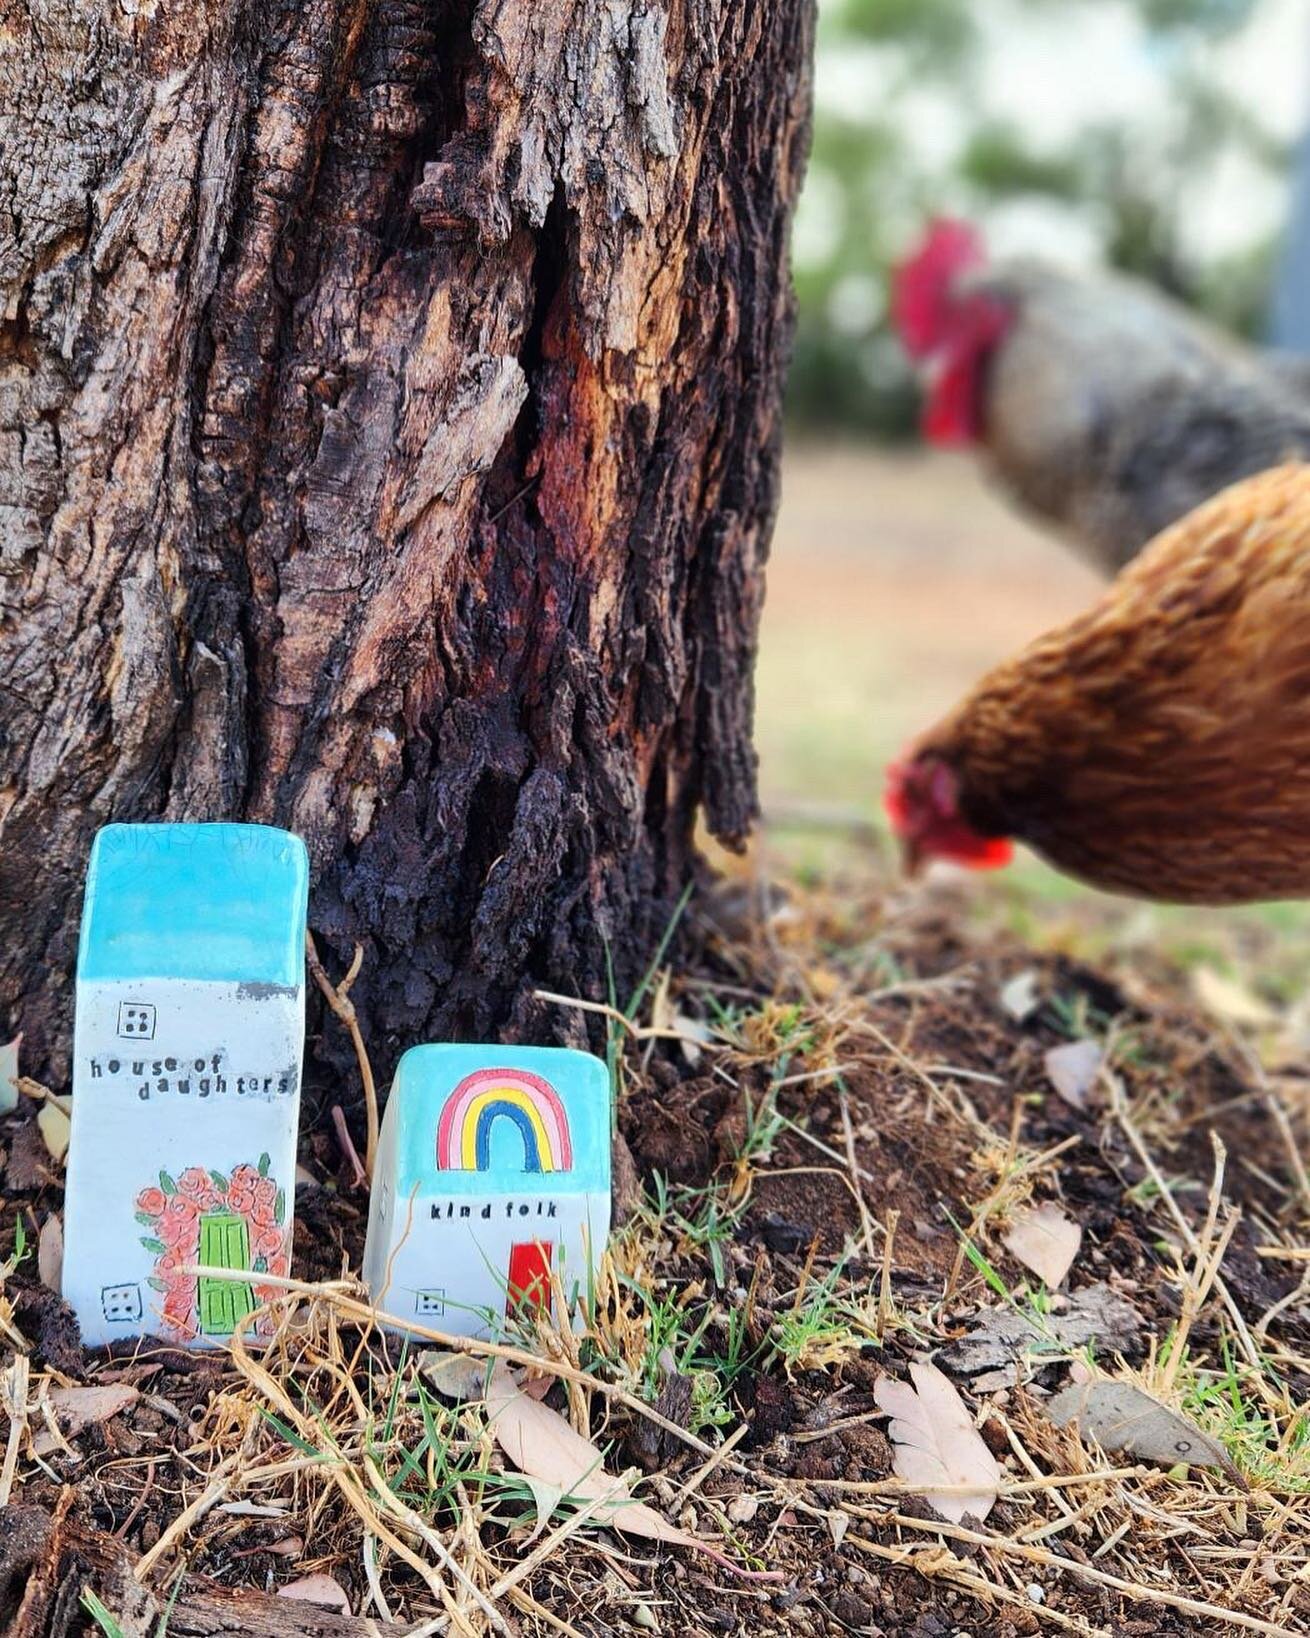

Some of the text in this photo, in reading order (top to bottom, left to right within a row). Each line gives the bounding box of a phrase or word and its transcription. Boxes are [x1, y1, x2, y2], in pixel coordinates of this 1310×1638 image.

[90, 1053, 223, 1078] house of
[138, 1074, 288, 1101] daughters
[430, 1201, 557, 1219] kind folk
